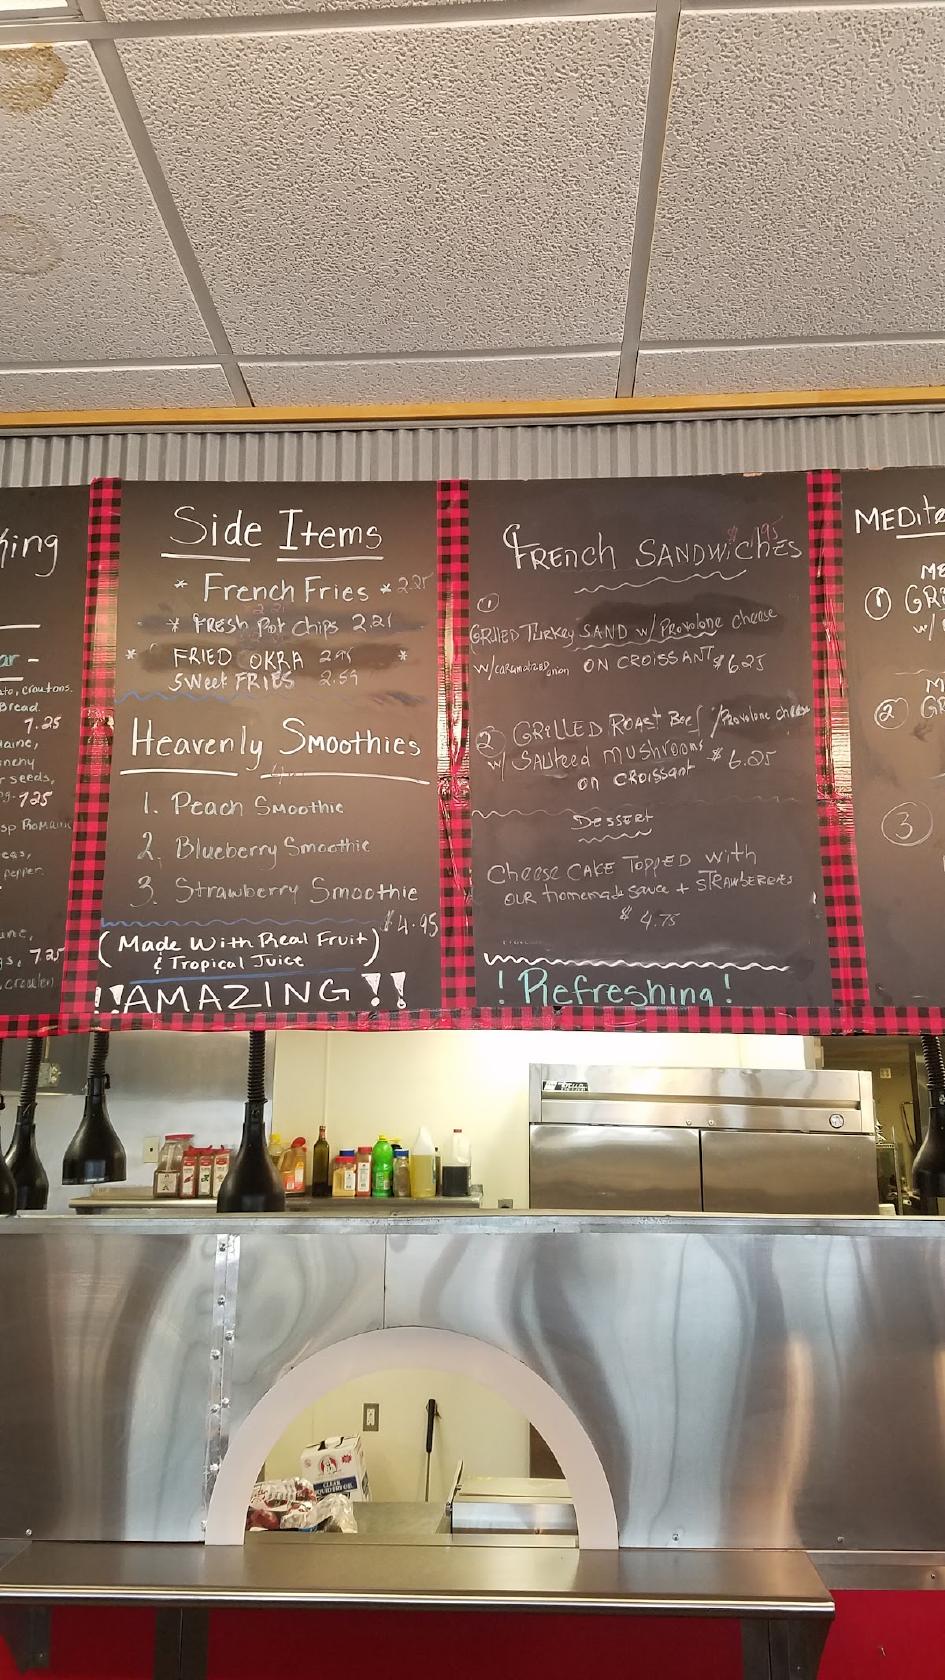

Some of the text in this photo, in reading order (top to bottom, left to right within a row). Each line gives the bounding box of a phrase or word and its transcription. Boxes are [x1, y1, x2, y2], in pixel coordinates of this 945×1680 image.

[169, 505, 383, 550] Side Items
[203, 572, 295, 603] French
[303, 575, 370, 603] Fries
[578, 623, 628, 640] SAND
[731, 607, 778, 630] cheese
[173, 647, 232, 667] FRIED
[250, 652, 305, 672] OKRA
[583, 658, 609, 673] ON
[616, 644, 715, 669] CROiSSANT
[234, 670, 295, 692] FRIES
[24, 715, 62, 735] 7.25
[131, 716, 421, 771] Heavenly Smoothies
[602, 738, 704, 766] mushrooms
[576, 776, 600, 792] on
[170, 790, 244, 817] Peach
[254, 795, 345, 817] Smoothie
[570, 808, 655, 830] Dessert
[175, 835, 278, 871] Blueberry
[283, 836, 371, 858] Smoothie
[486, 841, 758, 885] Cheese CAKE TOPPED with
[174, 876, 299, 905] Strawberry
[309, 876, 419, 904] Smoothie
[503, 890, 538, 906] OUR
[541, 882, 625, 904] homemade
[627, 883, 670, 900] sauce
[189, 935, 253, 952] With
[257, 931, 309, 947] Real
[168, 953, 245, 972] Tropical
[251, 952, 305, 970] Juice
[517, 966, 715, 1007] Refreshing
